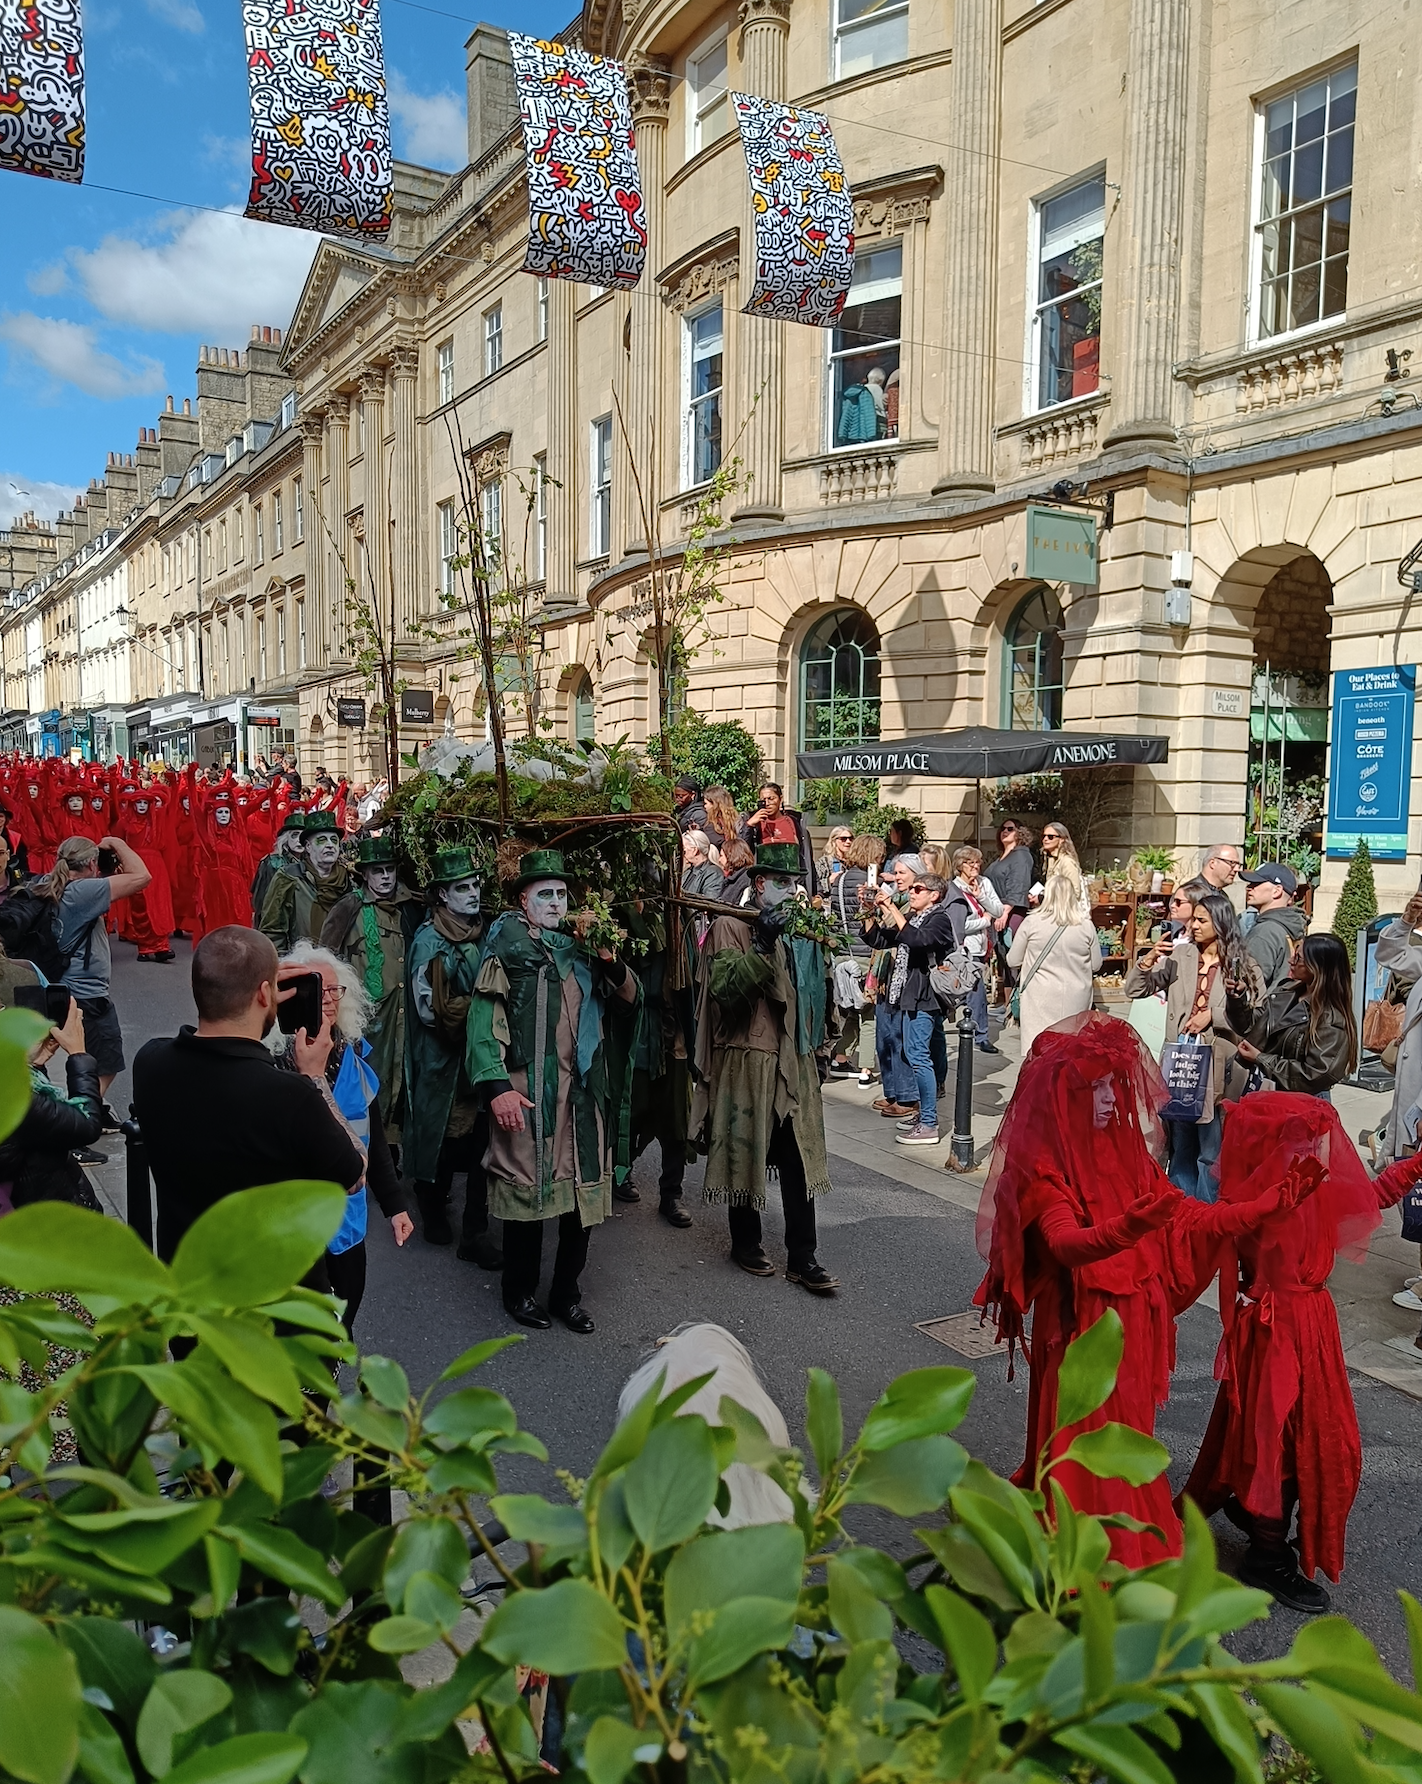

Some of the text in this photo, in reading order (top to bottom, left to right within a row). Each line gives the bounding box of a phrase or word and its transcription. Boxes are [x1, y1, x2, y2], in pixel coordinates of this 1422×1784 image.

[1034, 537, 1090, 555] THE IVY
[1349, 672, 1400, 683] Our Places to
[1352, 680, 1397, 691] Eat & Drink
[1215, 691, 1240, 702] MILSOM
[406, 708, 430, 717] Mulberry
[1217, 703, 1237, 713] PLACE
[1357, 716, 1385, 724] beneath
[1053, 743, 1117, 763] ANEMONE
[1357, 744, 1384, 754] CÔTE
[833, 753, 929, 771] MILSOM PLACE
[1171, 1051, 1203, 1061] Does my
[1169, 1070, 1200, 1080] look big
[1176, 1080, 1198, 1088] this?
